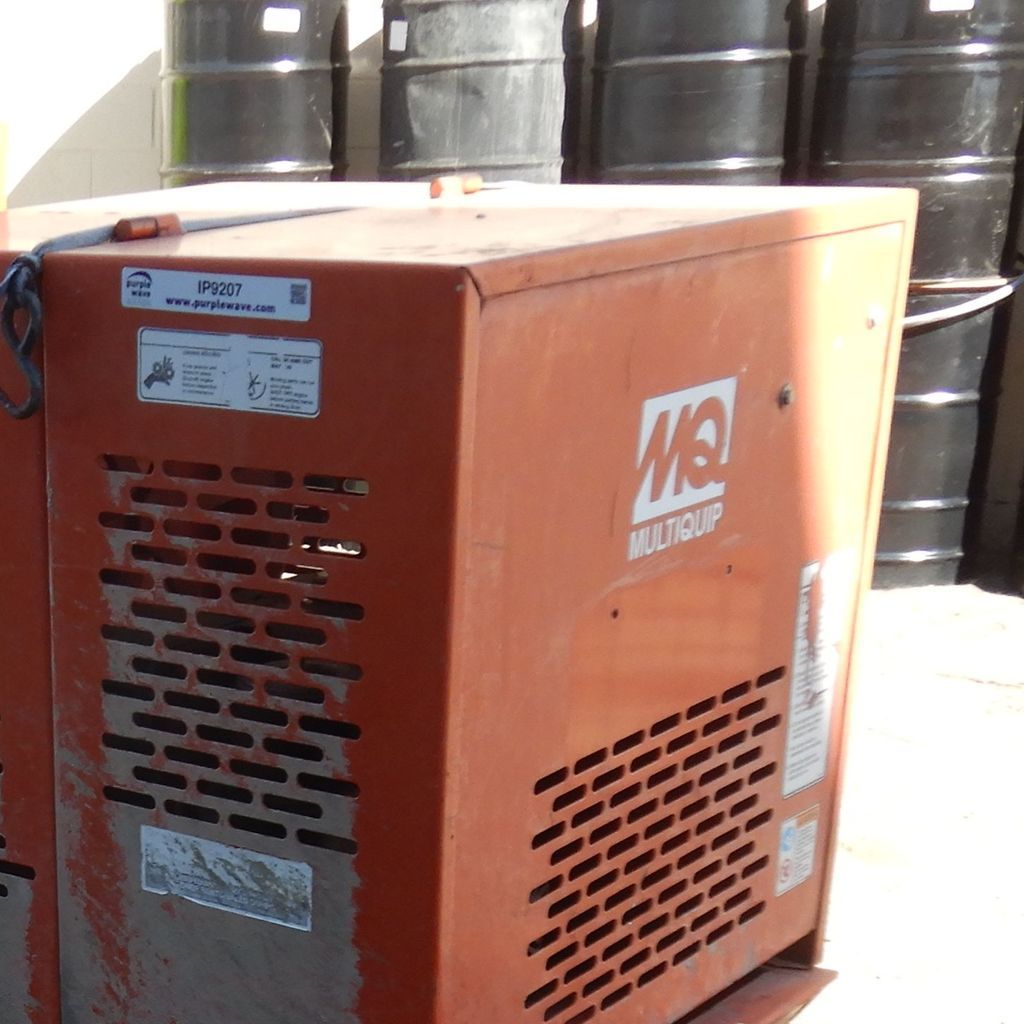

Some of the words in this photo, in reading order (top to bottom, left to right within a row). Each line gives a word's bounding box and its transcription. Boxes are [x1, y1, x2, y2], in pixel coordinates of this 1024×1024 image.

[126, 279, 152, 289] purple
[197, 280, 243, 297] IP9207
[131, 289, 151, 298] wave
[165, 296, 276, 314] www.purplewave.com
[634, 386, 733, 512] MQ
[628, 502, 723, 561] MULTIQUIP
